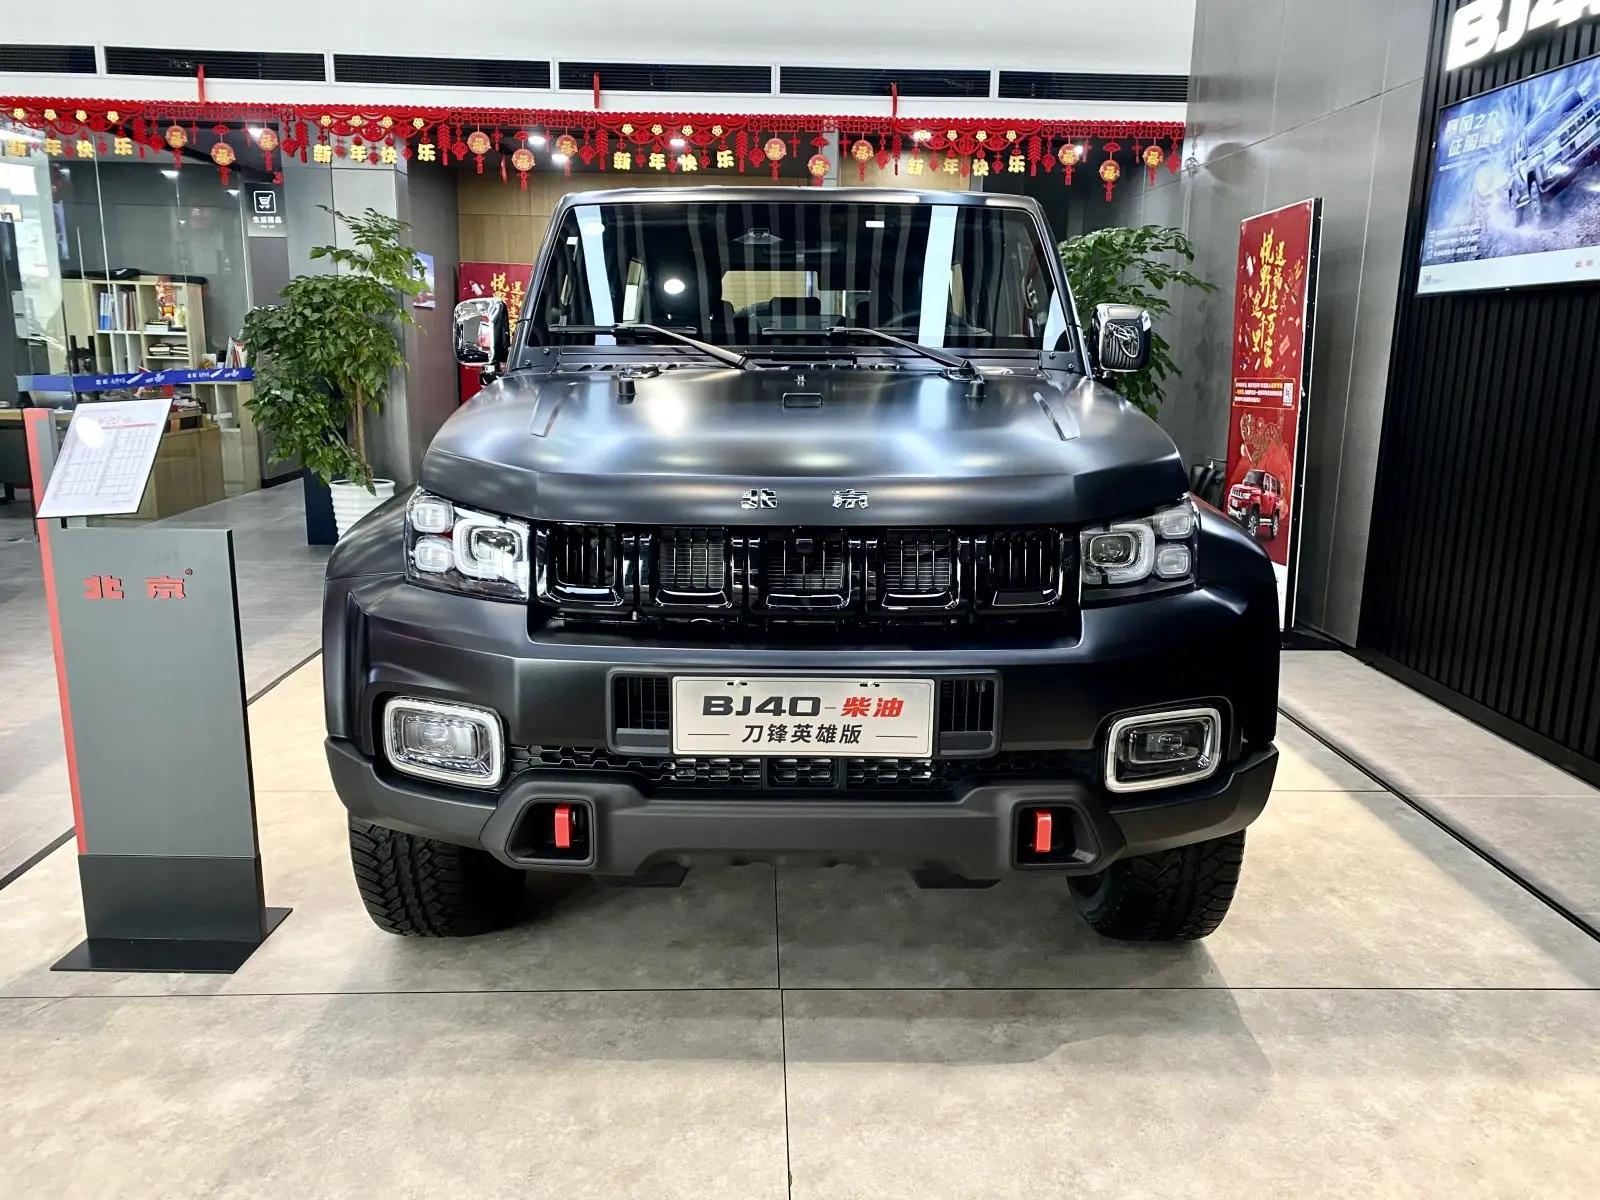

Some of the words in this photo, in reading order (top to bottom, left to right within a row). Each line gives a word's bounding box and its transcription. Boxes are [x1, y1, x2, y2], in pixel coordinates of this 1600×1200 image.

[313, 143, 436, 164] 新年快乐
[613, 149, 735, 172] 新年快乐
[906, 155, 1025, 177] 新年快乐
[742, 723, 863, 744] 刀锋英雄版
